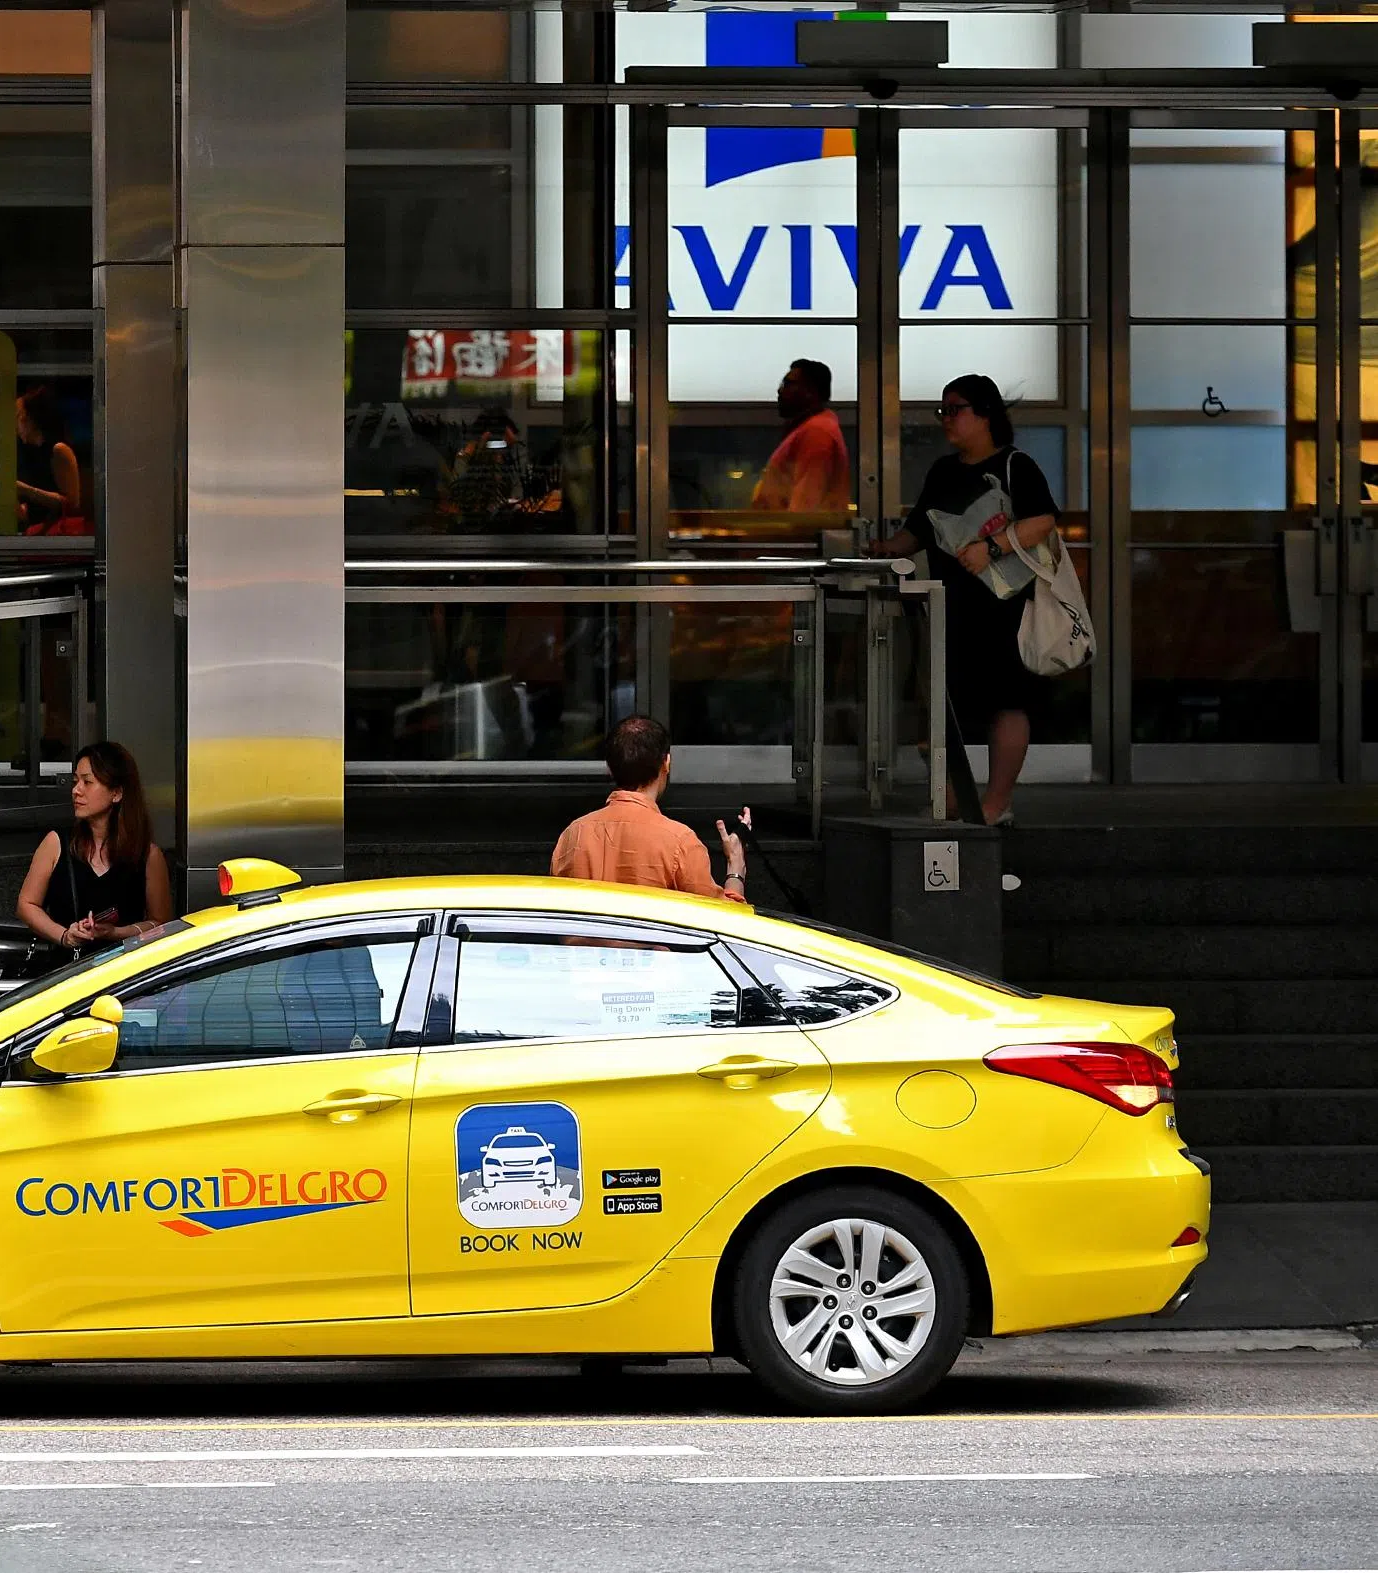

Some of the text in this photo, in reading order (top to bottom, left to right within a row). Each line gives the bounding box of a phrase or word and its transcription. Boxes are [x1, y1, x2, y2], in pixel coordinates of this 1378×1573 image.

[605, 1005, 651, 1014] Flag Down
[619, 1175, 659, 1185] Google play
[617, 1201, 659, 1213] App Store
[460, 1231, 583, 1253] BOOK NOW
